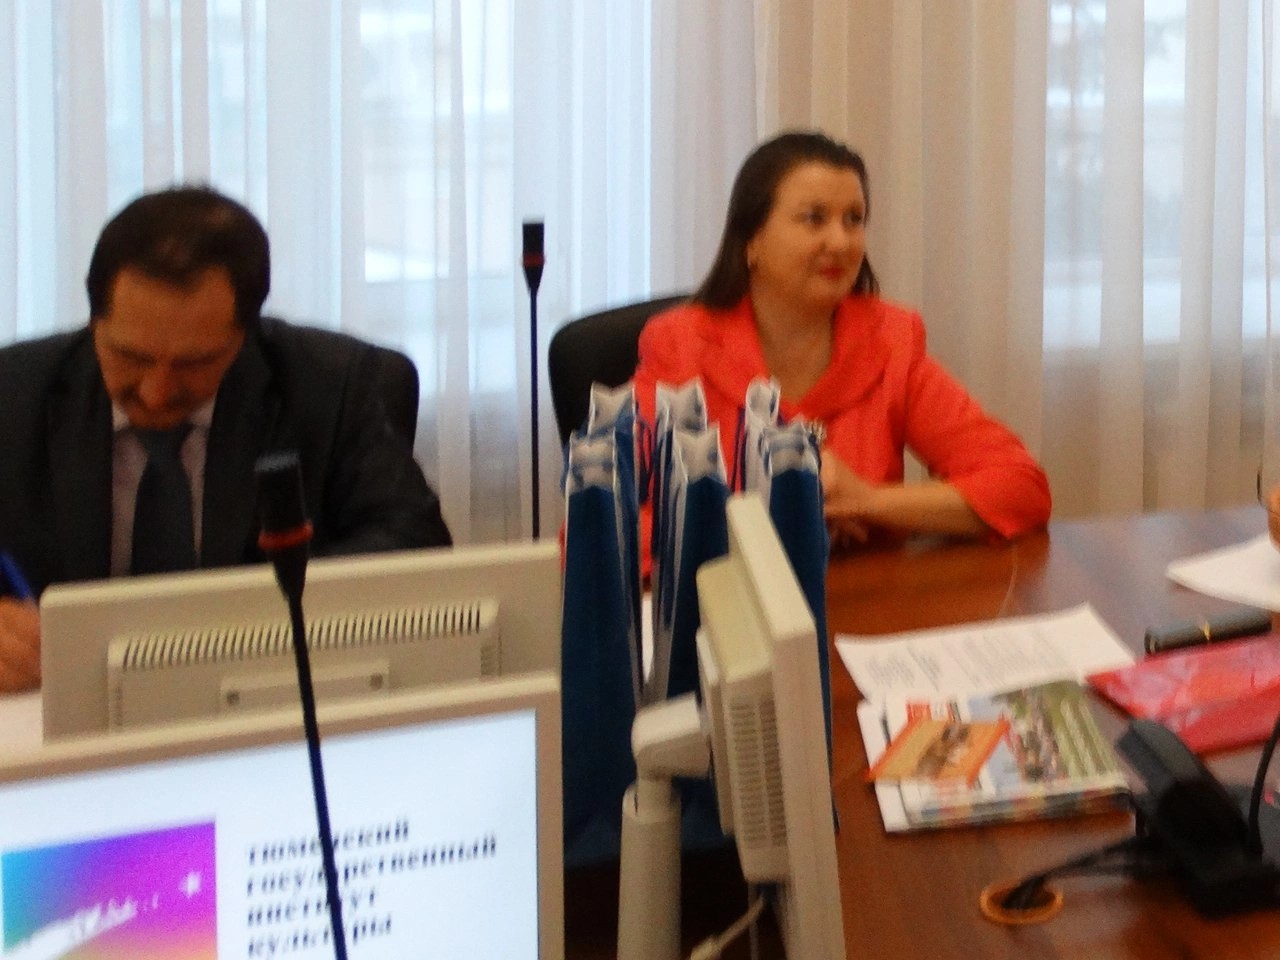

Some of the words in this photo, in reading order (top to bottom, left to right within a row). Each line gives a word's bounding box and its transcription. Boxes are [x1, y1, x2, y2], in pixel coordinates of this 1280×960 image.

[247, 834, 496, 896] госудрственный
[248, 887, 376, 927] инстиут
[248, 914, 391, 959] культры
